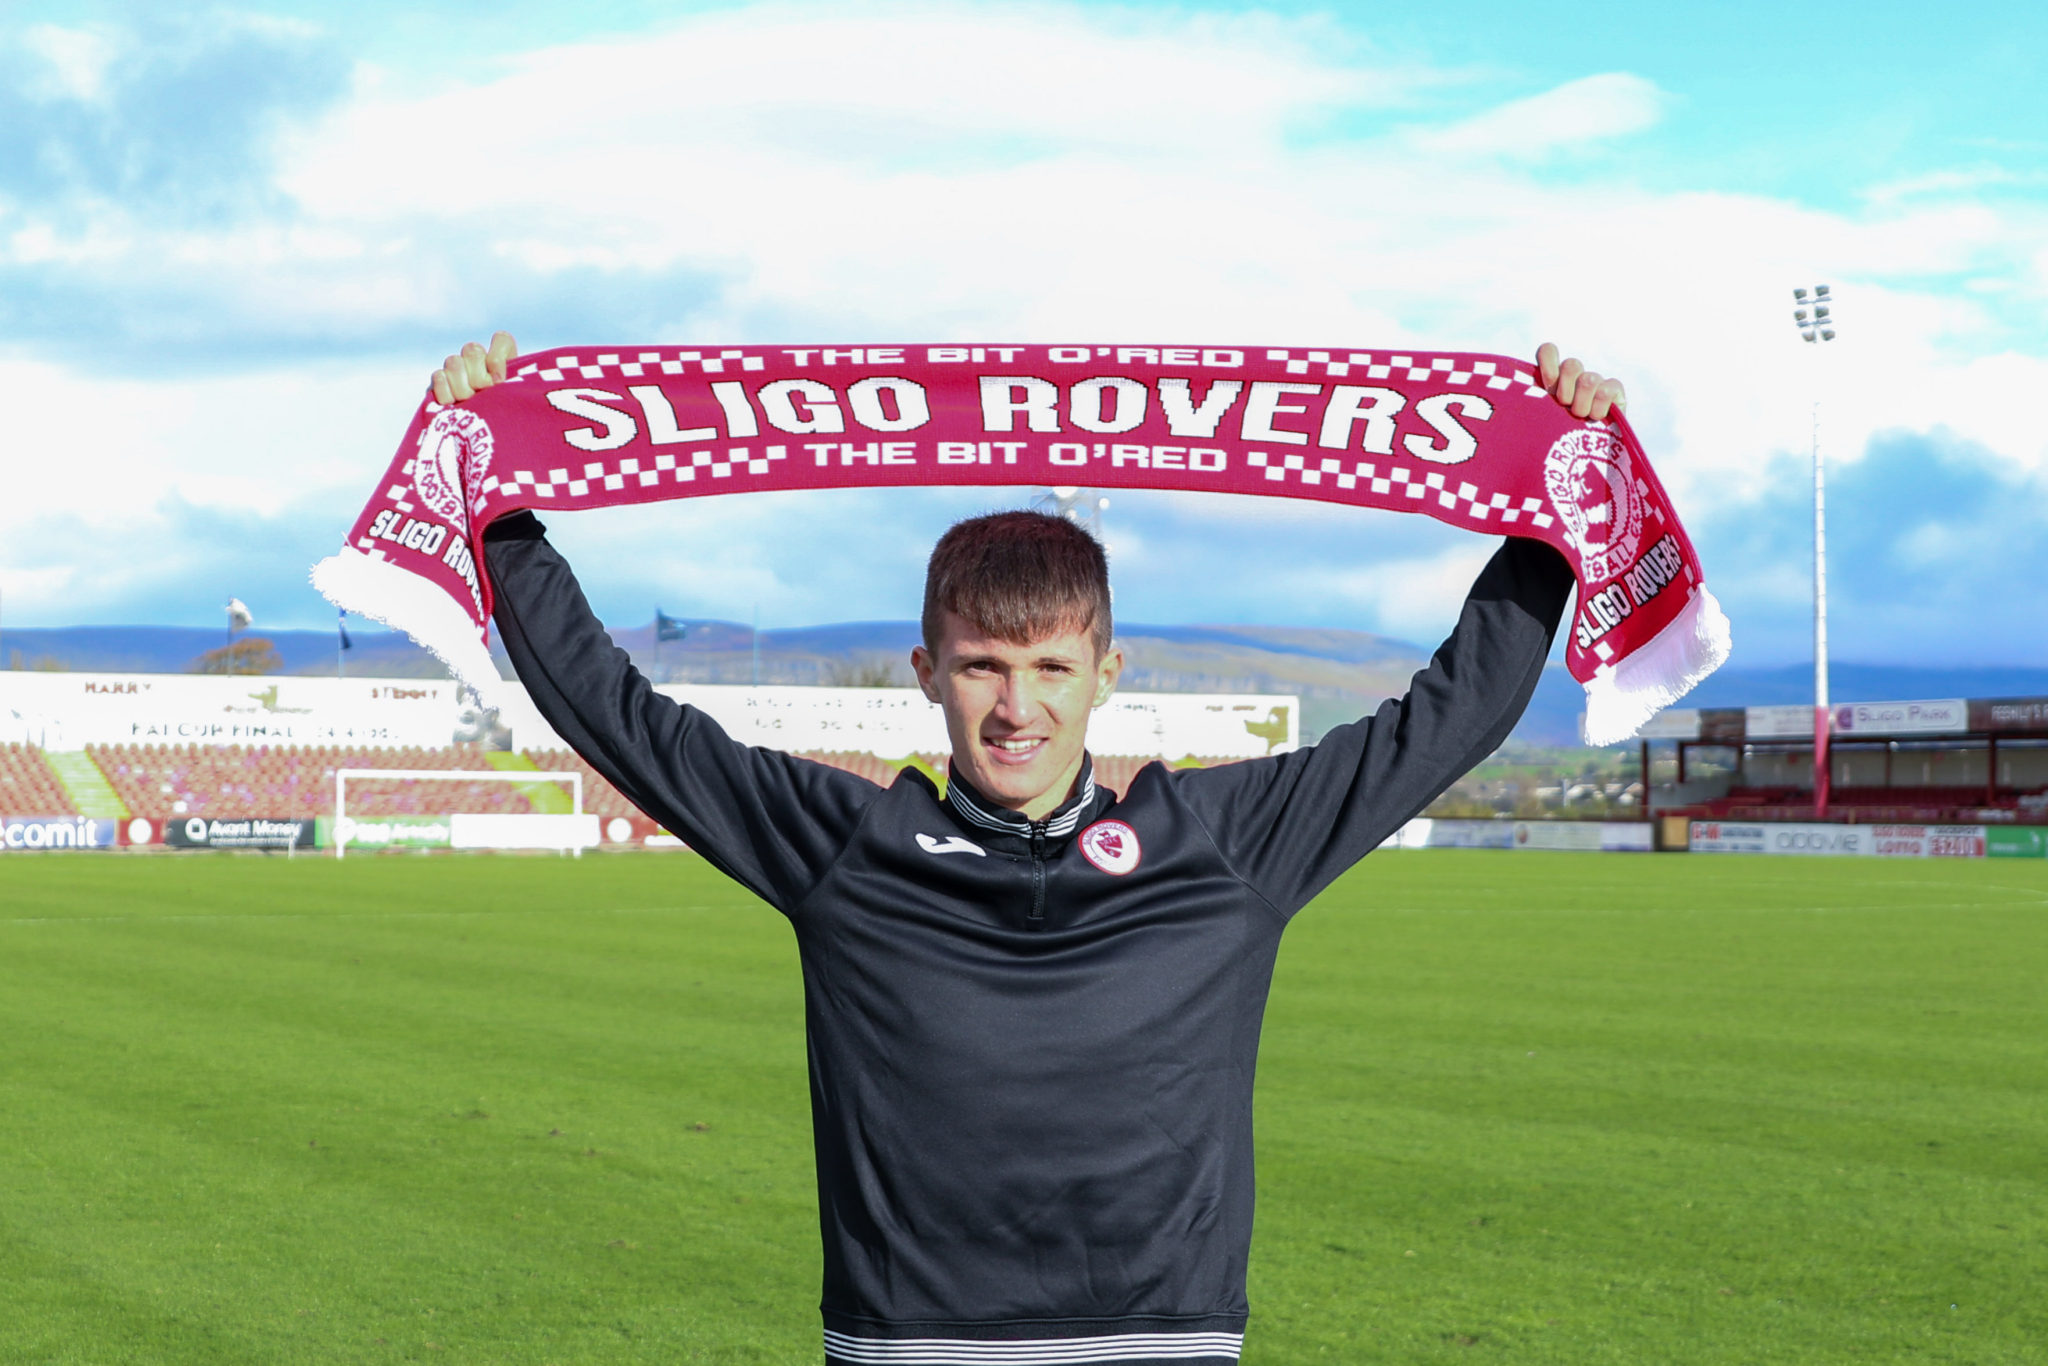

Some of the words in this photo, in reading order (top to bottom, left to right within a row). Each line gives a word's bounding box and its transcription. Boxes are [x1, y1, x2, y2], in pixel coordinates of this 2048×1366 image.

[781, 349, 905, 366] THE
[927, 347, 1025, 363] BIT
[1048, 347, 1244, 367] O'RED
[545, 375, 930, 452] SLIGO
[977, 375, 1494, 465] ROVERS
[804, 442, 917, 466] THE
[937, 442, 1027, 464] BIT
[1049, 442, 1227, 472] O'RED
[367, 507, 449, 556] SLIGO
[1576, 582, 1633, 649] SLIGO
